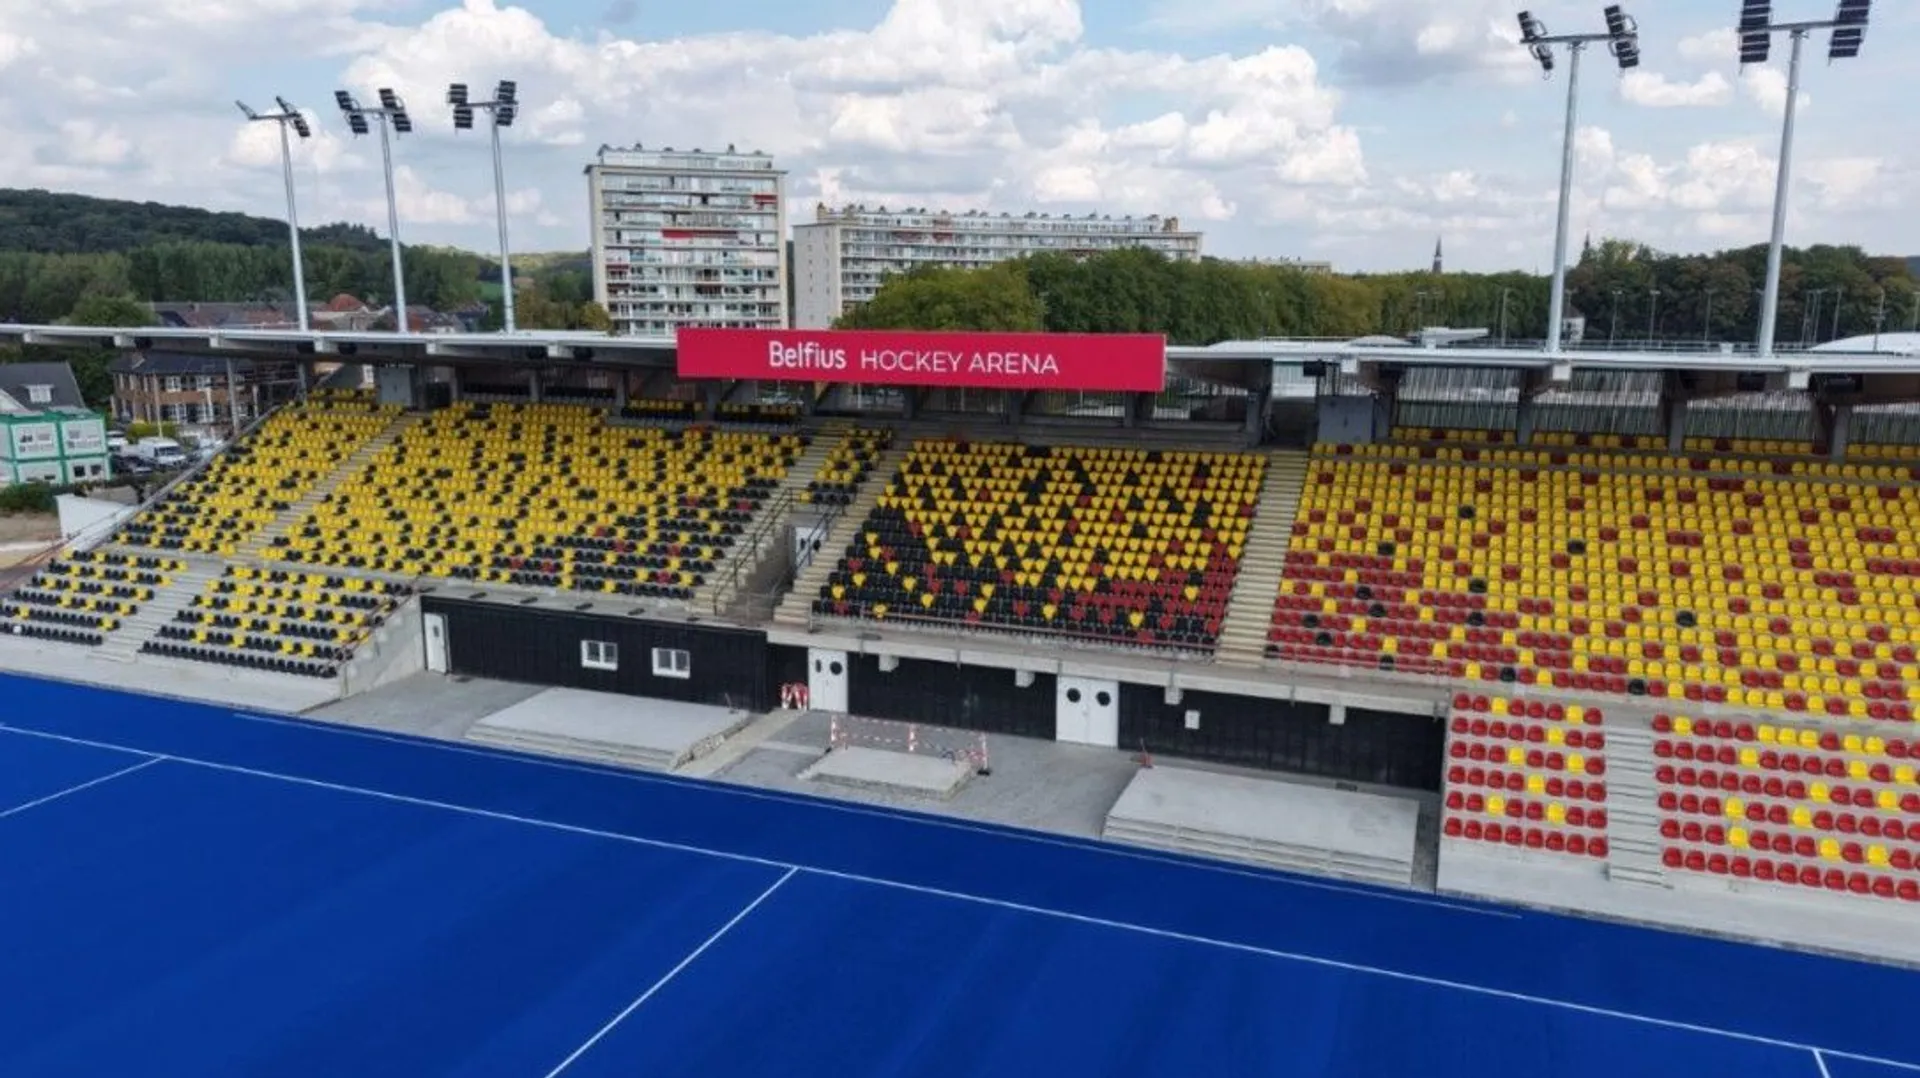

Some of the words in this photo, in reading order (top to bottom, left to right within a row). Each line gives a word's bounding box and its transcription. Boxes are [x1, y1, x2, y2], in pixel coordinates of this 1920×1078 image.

[769, 341, 846, 369] Belfius
[861, 350, 962, 372] HOCKEY
[970, 352, 1059, 375] ARENA
